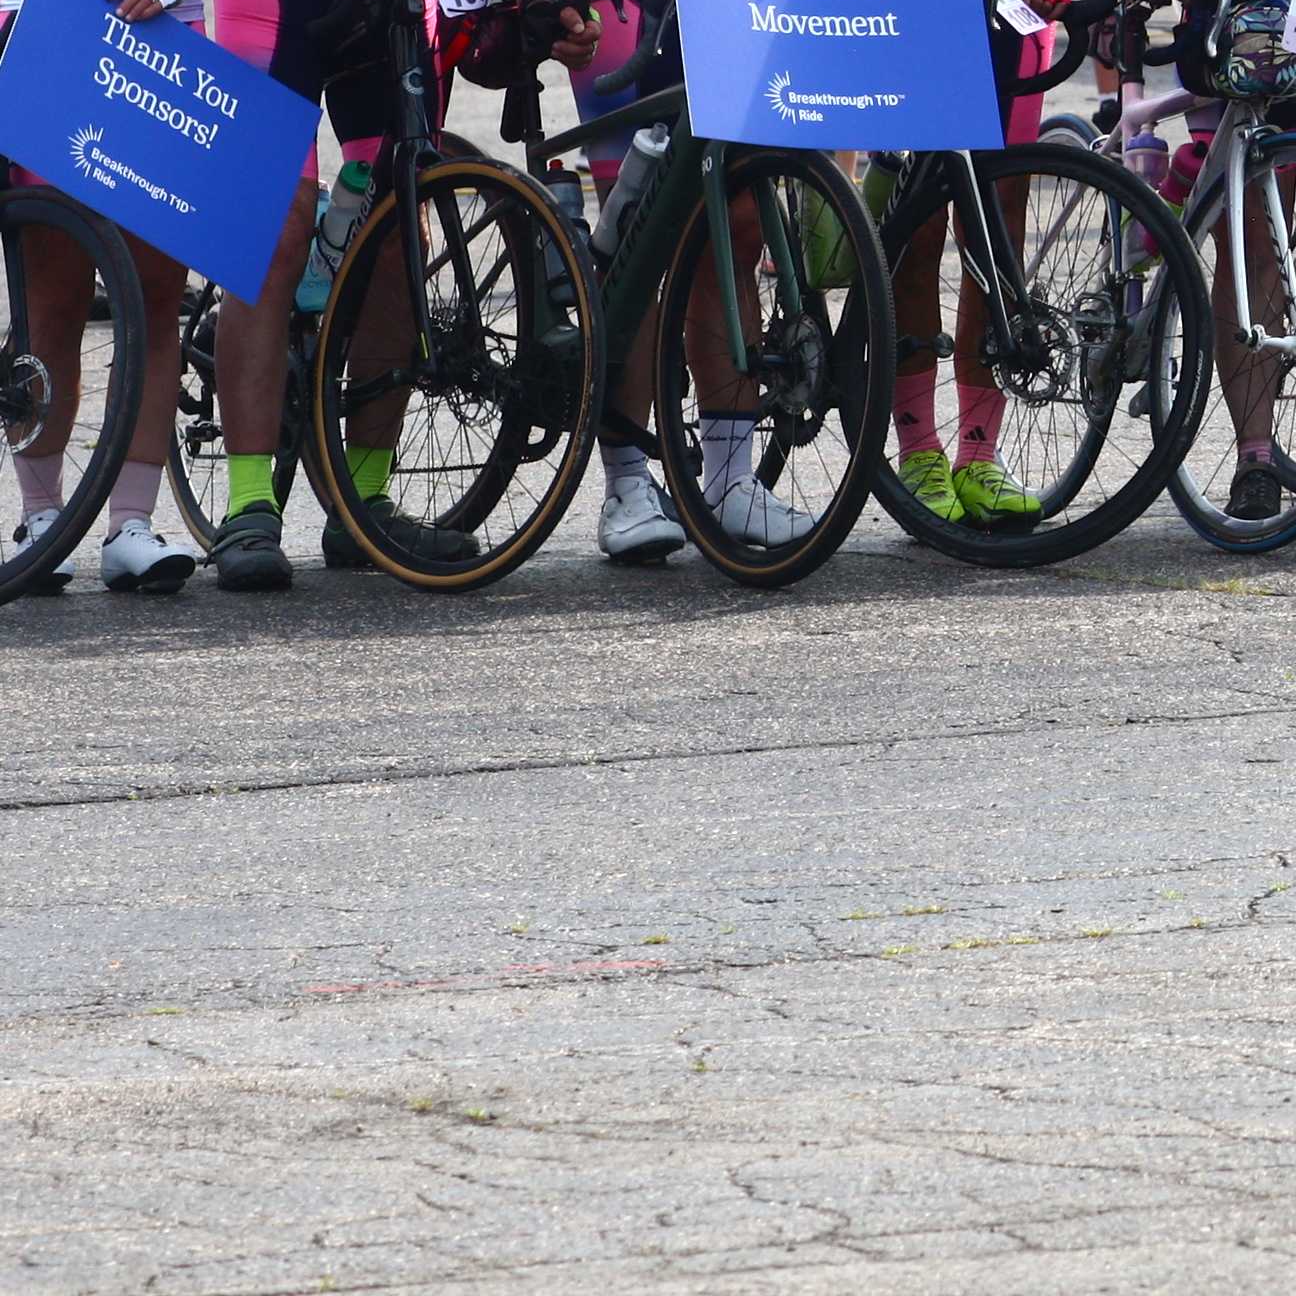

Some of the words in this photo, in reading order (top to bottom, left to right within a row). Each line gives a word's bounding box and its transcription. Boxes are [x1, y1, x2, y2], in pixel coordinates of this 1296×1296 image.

[748, 2, 899, 36] Movement
[103, 13, 185, 86] Thank
[193, 68, 237, 119] You
[94, 57, 218, 149] Sponsors!
[789, 92, 873, 109] Breakthrough
[799, 110, 823, 121] Ride
[91, 148, 167, 201] Breakthrough
[93, 167, 115, 189] Ride
